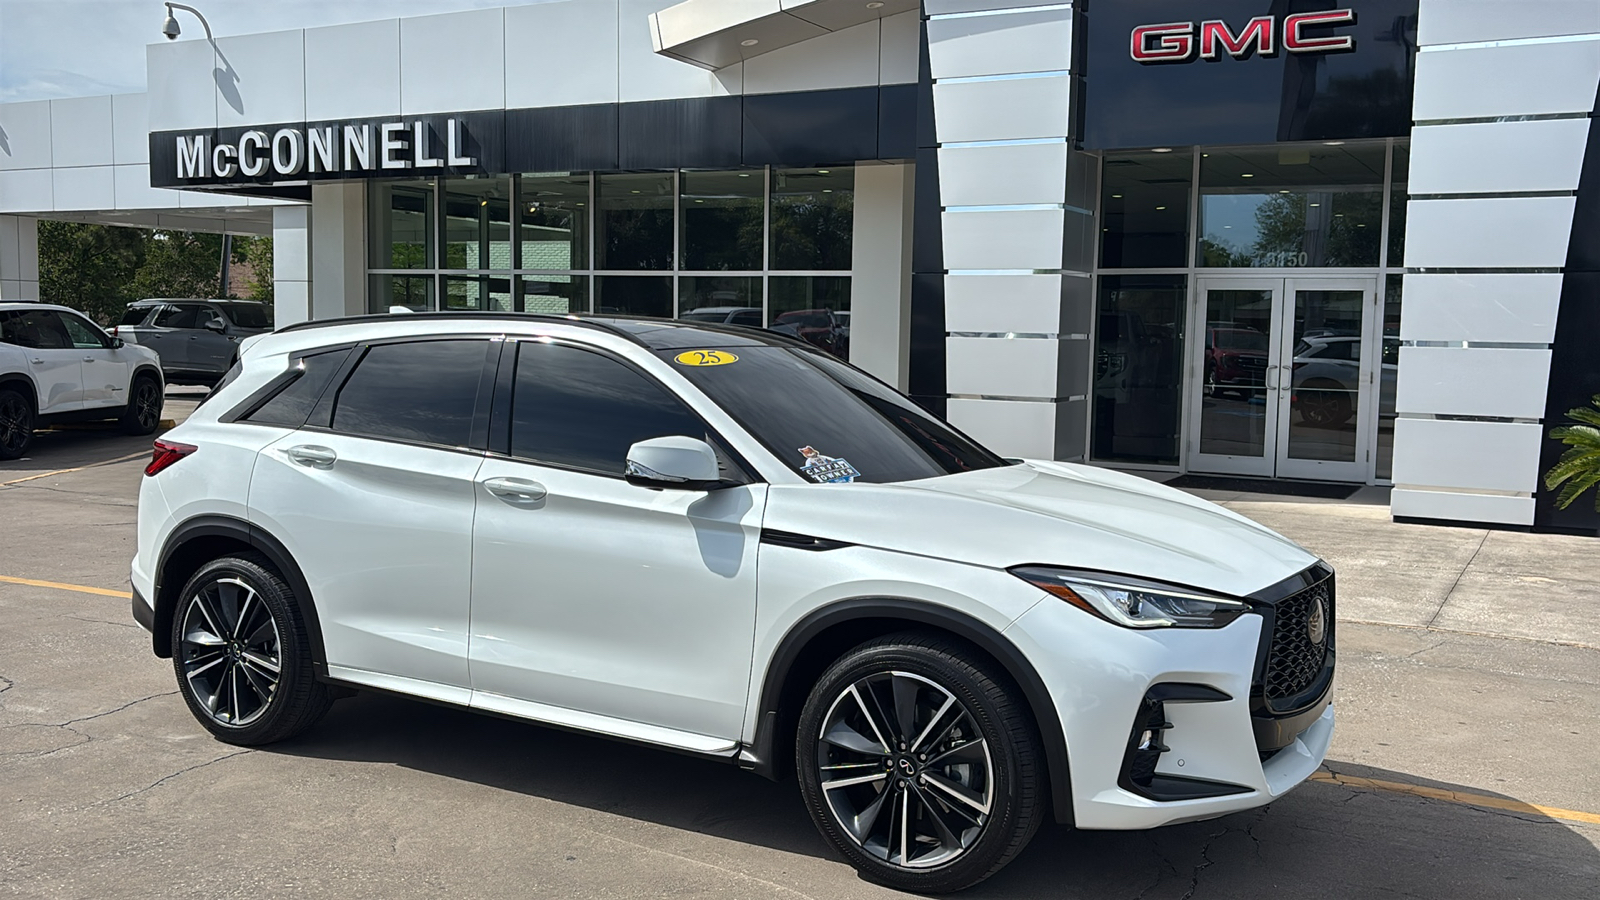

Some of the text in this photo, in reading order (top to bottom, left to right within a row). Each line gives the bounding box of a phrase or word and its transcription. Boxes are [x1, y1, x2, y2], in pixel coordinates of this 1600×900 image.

[1130, 8, 1354, 62] GMC
[175, 118, 477, 179] McCONNELL
[693, 351, 721, 364] 25
[806, 460, 850, 475] CARFAX
[820, 468, 855, 481] OWNER
